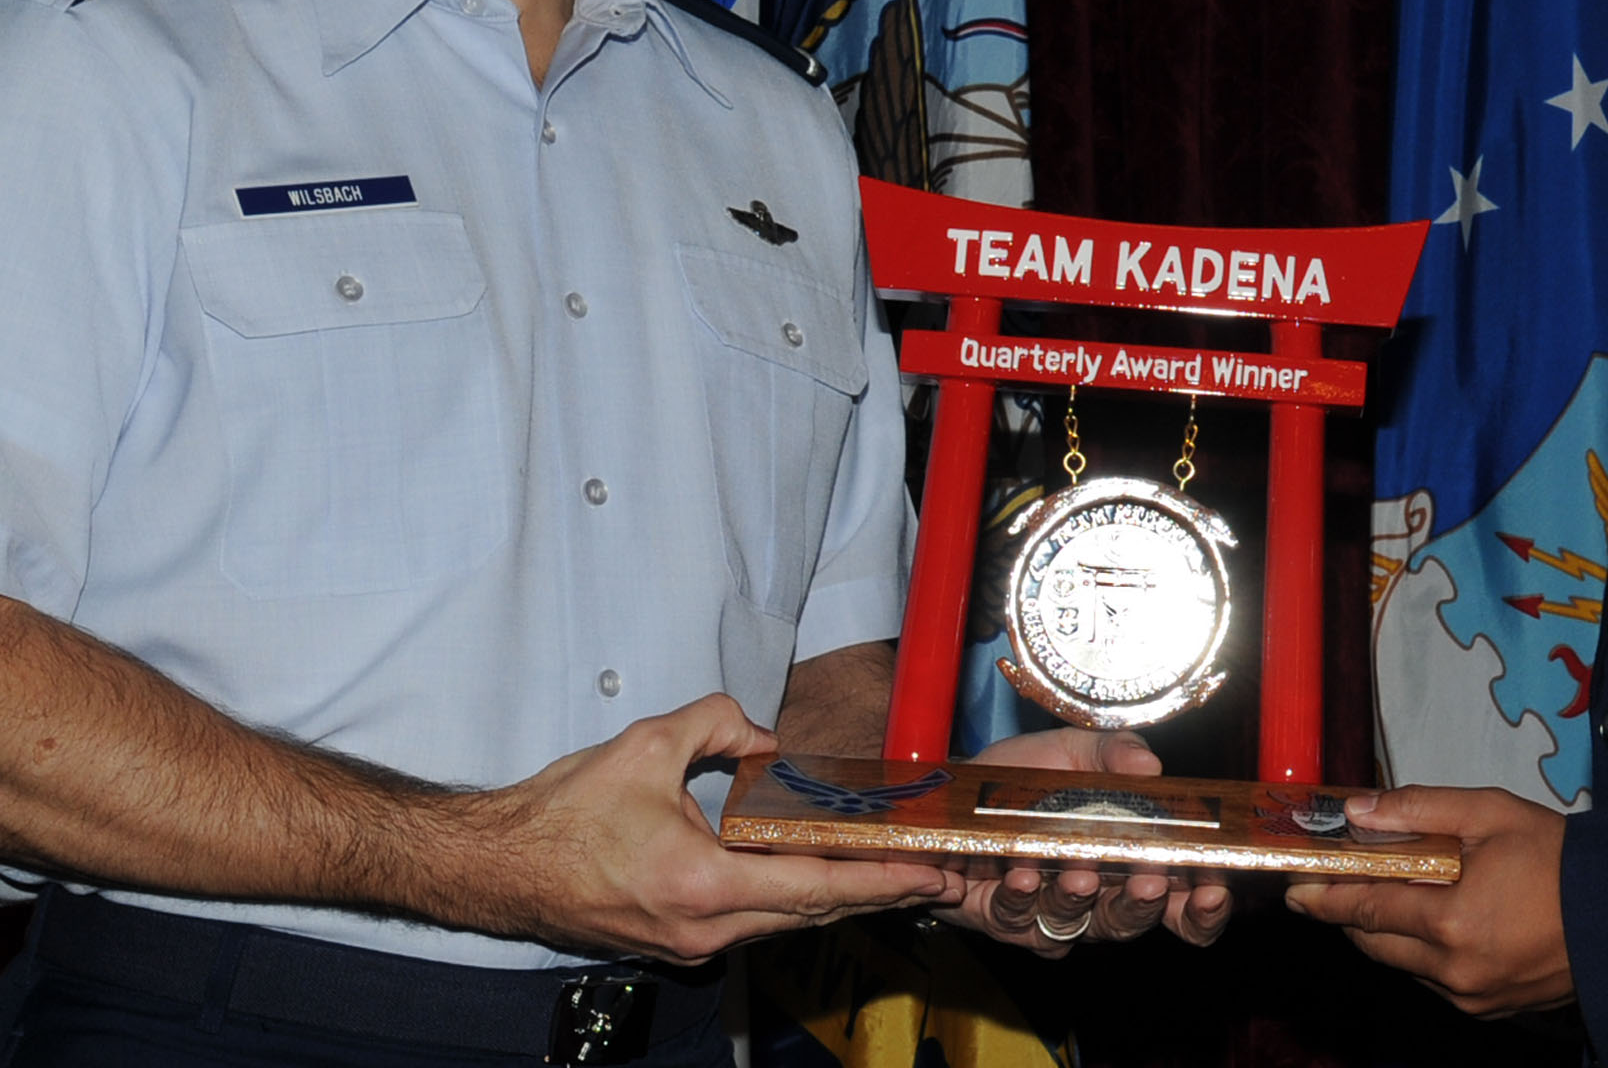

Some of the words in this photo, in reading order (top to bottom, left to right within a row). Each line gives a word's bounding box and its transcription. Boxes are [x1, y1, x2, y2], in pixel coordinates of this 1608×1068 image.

[287, 185, 364, 206] WILSBACH
[946, 227, 1095, 285] TEAM
[1115, 239, 1331, 305] KADENA
[960, 337, 1102, 383] Quarterly
[1111, 349, 1203, 384] Award
[1211, 353, 1308, 391] Winner
